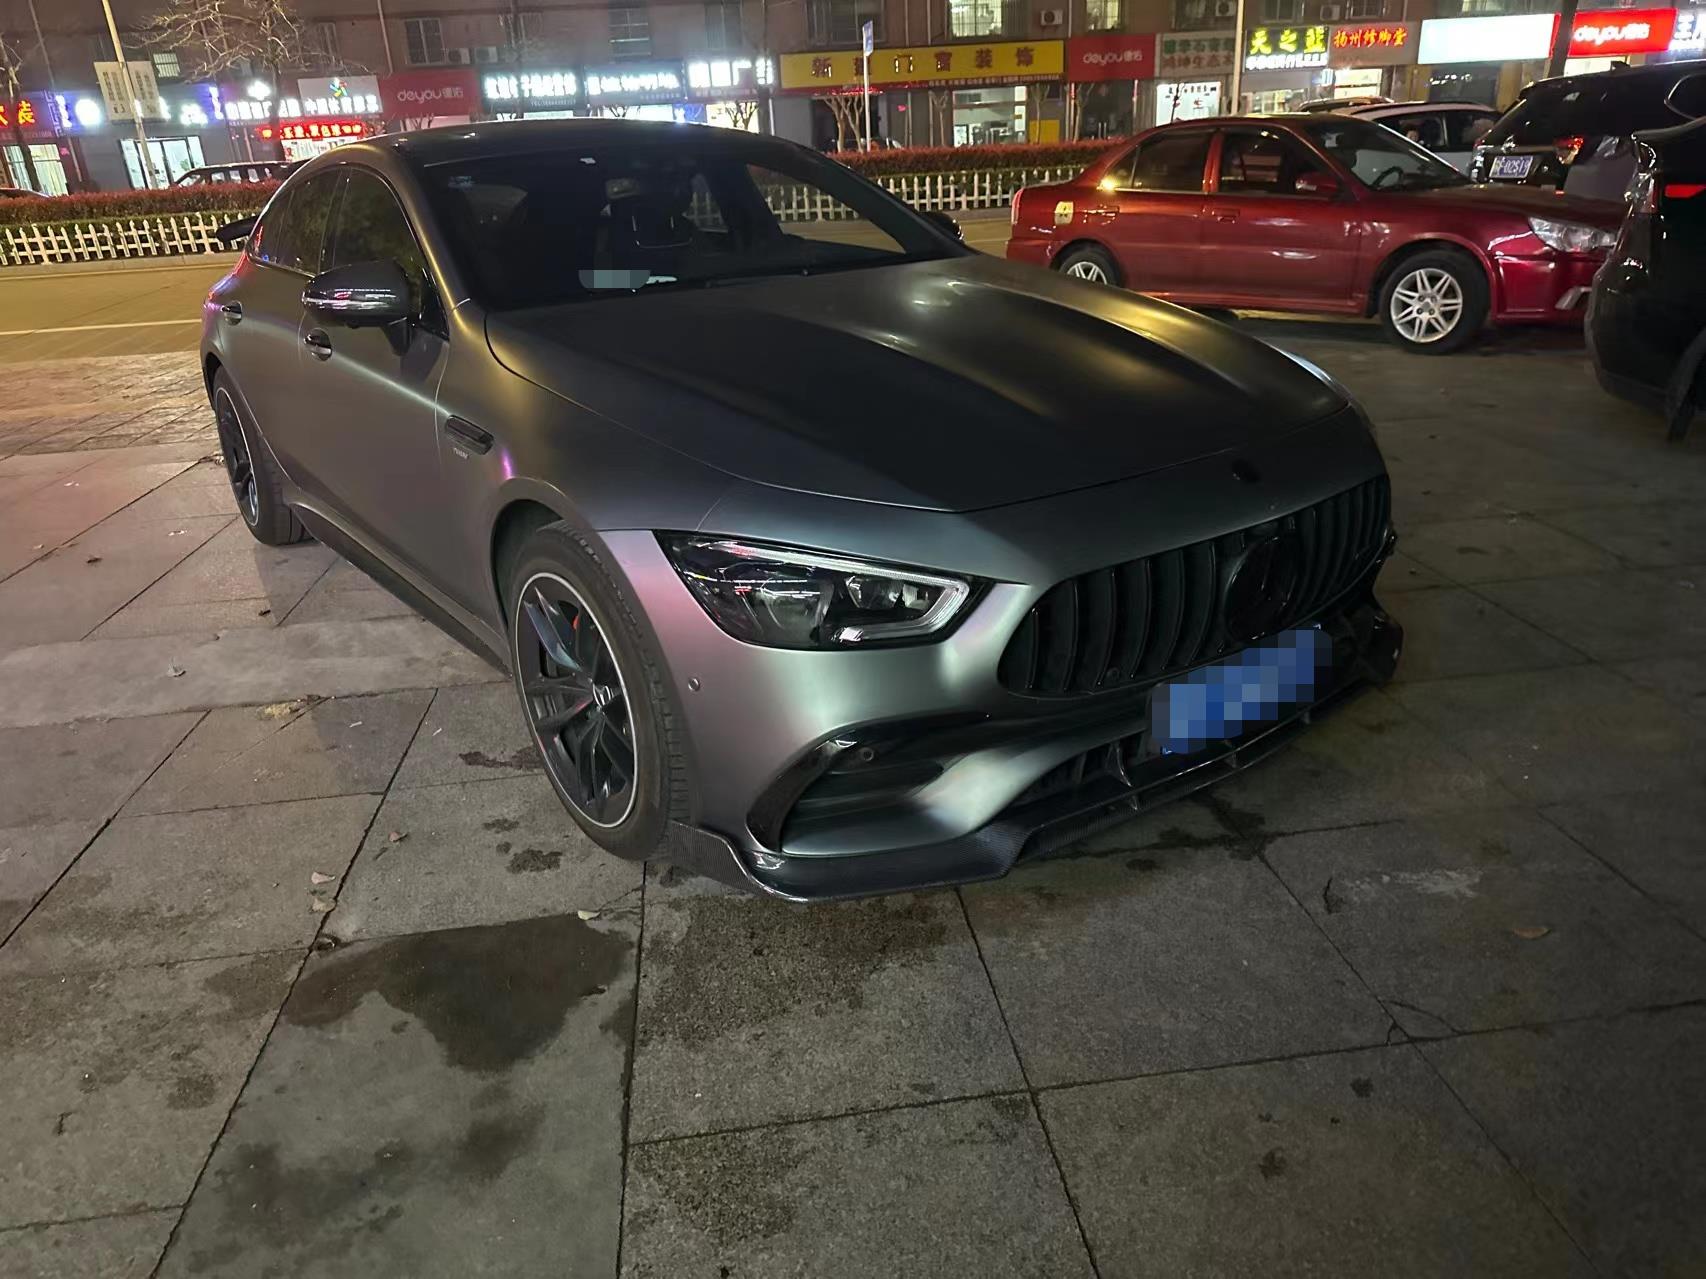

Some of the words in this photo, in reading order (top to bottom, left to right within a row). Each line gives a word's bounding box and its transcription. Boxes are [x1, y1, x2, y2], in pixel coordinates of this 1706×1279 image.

[1333, 27, 1408, 48] 扬州修脚堂
